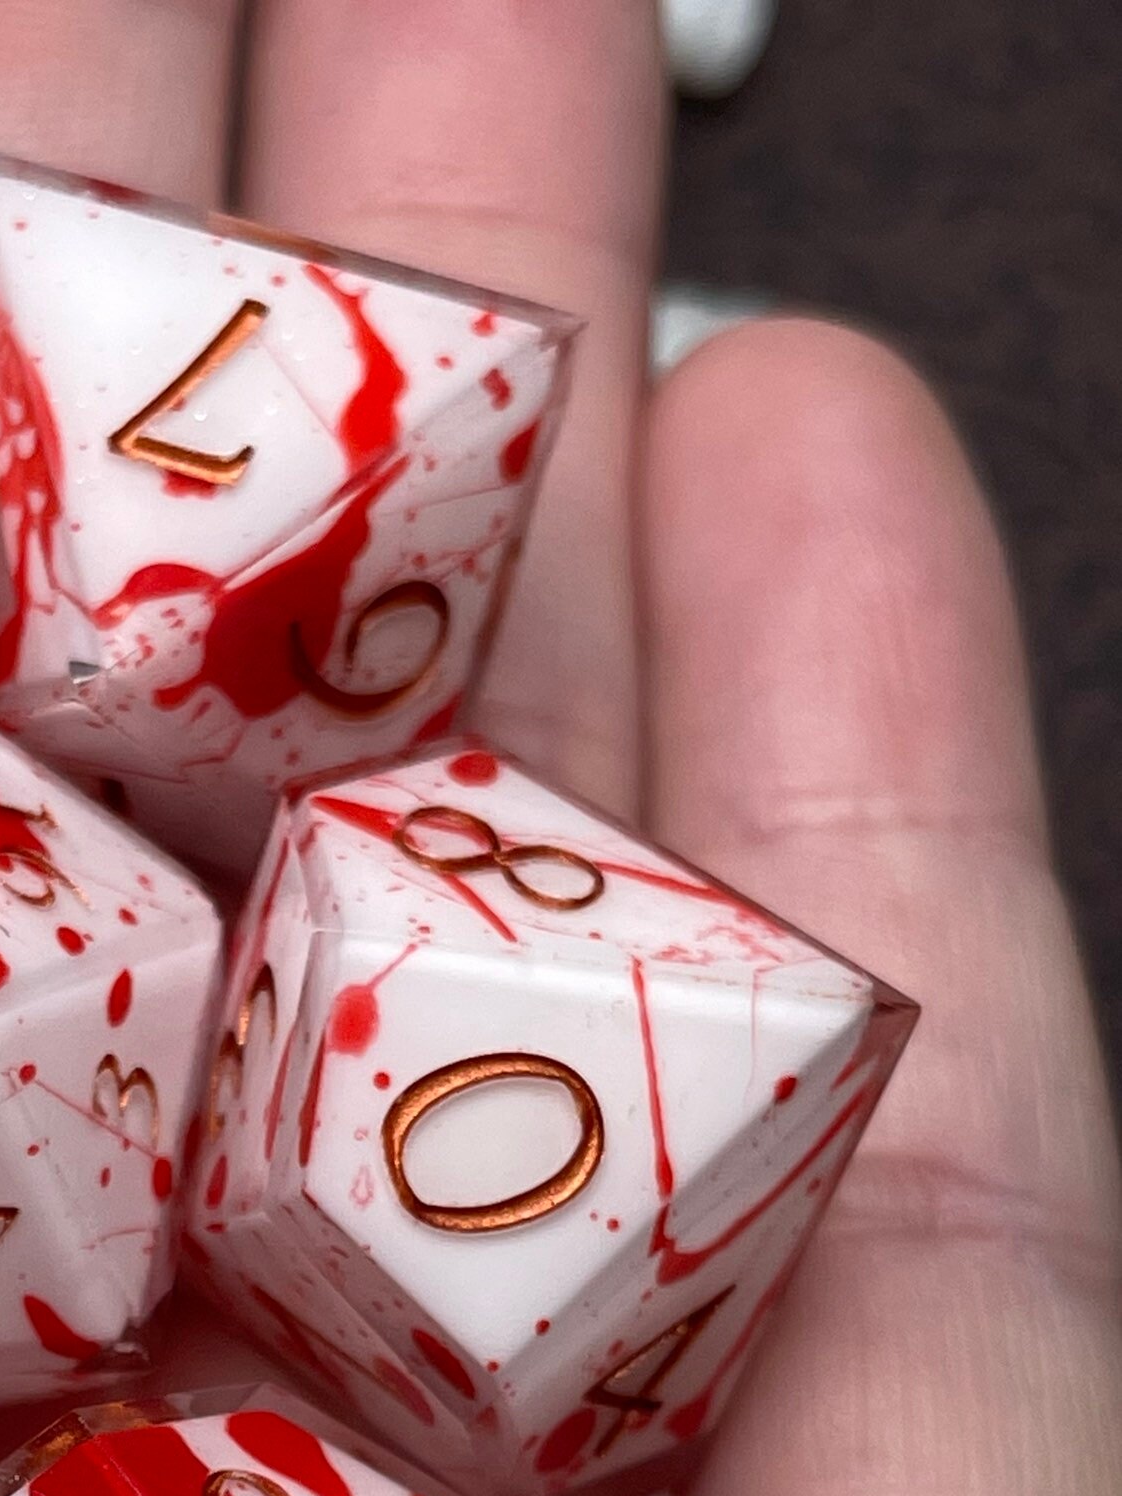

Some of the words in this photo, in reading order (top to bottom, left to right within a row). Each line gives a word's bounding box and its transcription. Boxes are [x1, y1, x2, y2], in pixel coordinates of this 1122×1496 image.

[108, 297, 270, 486] 7
[393, 806, 605, 910] 8
[91, 1052, 161, 1152] 3
[381, 1051, 605, 1235] 0
